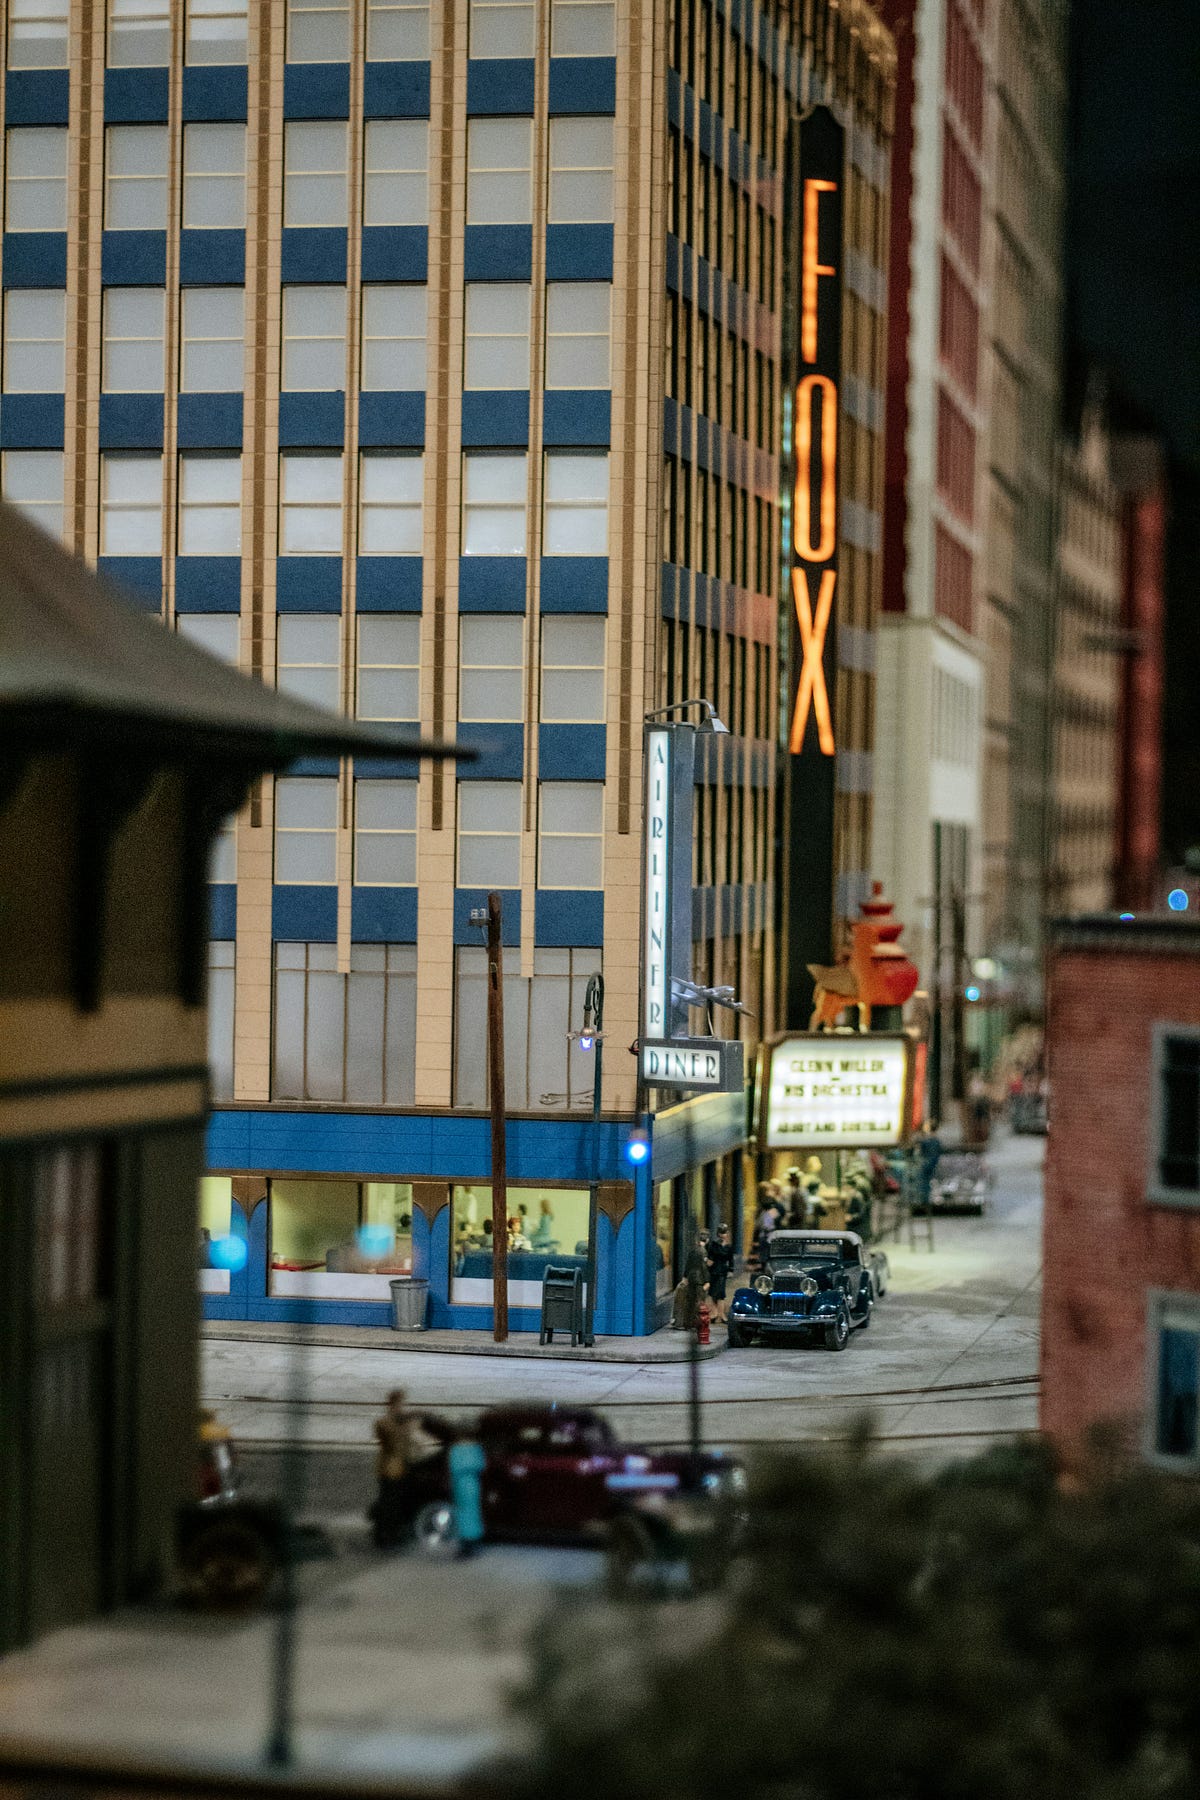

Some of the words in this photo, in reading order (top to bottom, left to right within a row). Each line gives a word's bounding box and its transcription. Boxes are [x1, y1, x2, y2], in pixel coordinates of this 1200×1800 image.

[789, 177, 837, 756] FOX
[650, 742, 665, 1025] AIRLINER
[649, 1051, 717, 1079] DINER
[790, 1060, 833, 1073] GLENN
[840, 1060, 884, 1073] MILLER
[811, 1084, 888, 1097] ORCHESTRA
